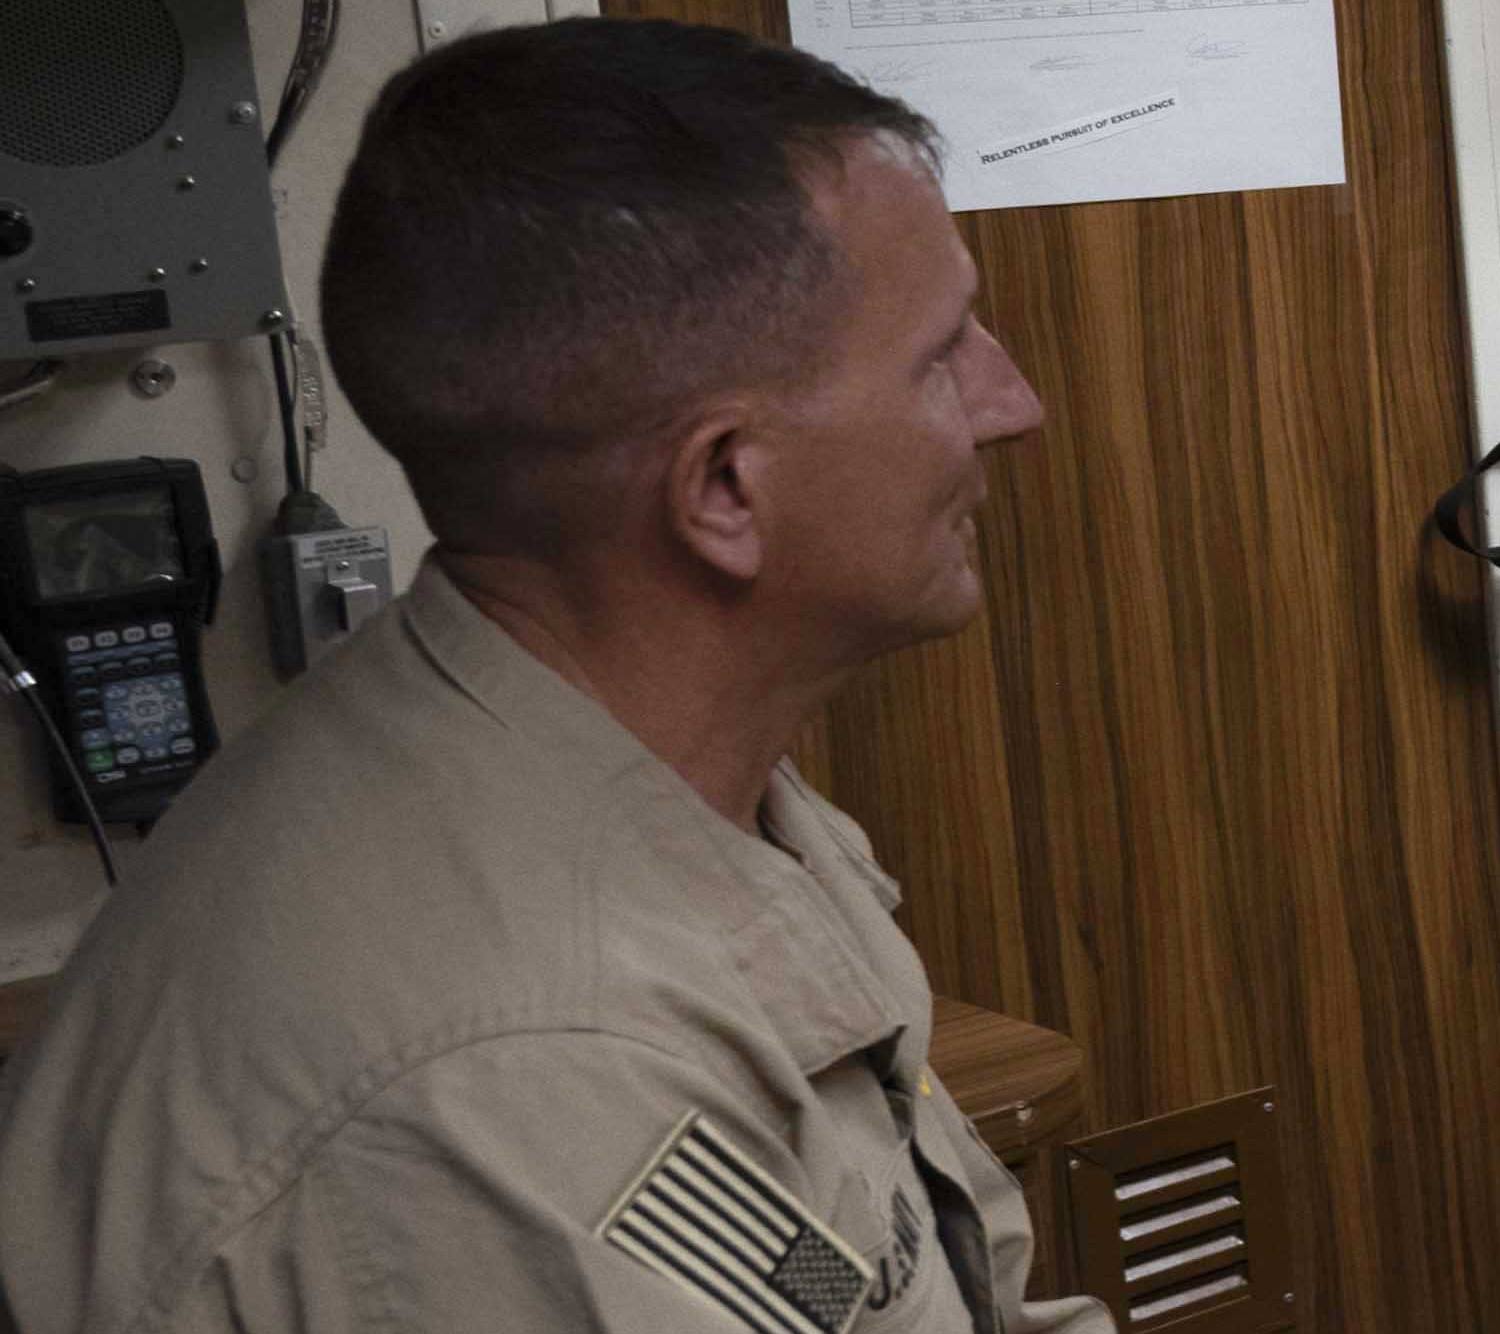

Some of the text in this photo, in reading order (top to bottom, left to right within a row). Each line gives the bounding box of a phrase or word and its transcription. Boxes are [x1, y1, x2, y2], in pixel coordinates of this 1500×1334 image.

[980, 97, 1176, 165] RELENTLESS PURSUIT OF EXCELLENCE
